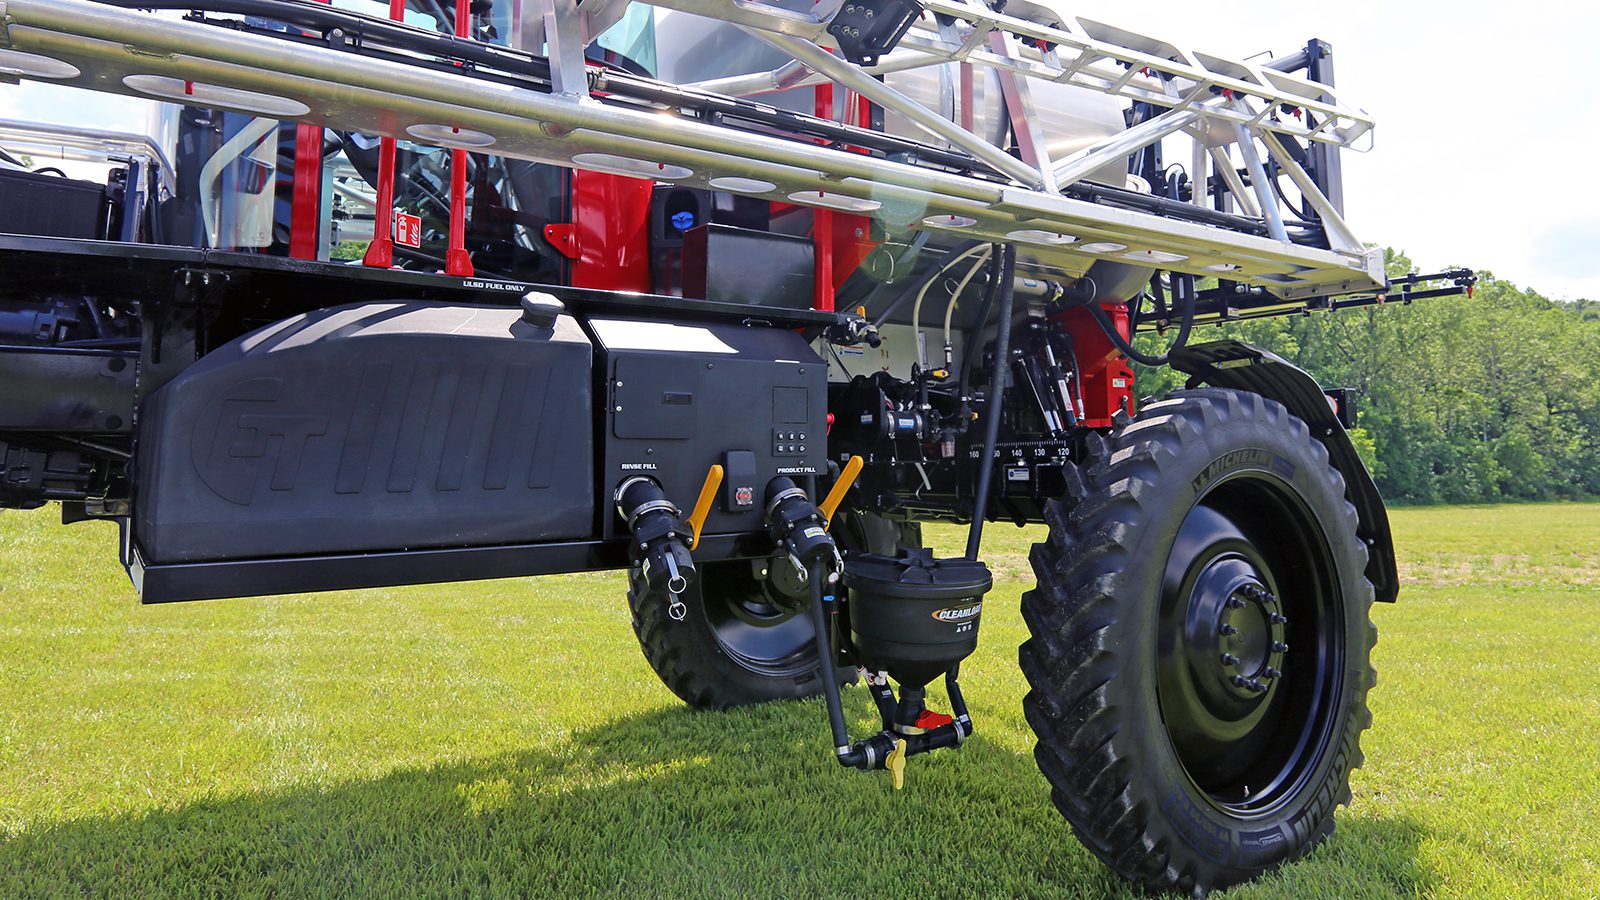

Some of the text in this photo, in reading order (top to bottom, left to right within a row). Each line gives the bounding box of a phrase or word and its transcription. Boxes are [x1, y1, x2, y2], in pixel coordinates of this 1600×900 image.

[463, 280, 526, 292] ULSD FUEL ONLY
[969, 450, 980, 458] 160
[1011, 449, 1023, 457] 140
[1033, 448, 1046, 456] 130
[1057, 447, 1070, 456] 120
[1208, 448, 1271, 478] MICHELIN
[1293, 708, 1358, 848] MICHELIN
